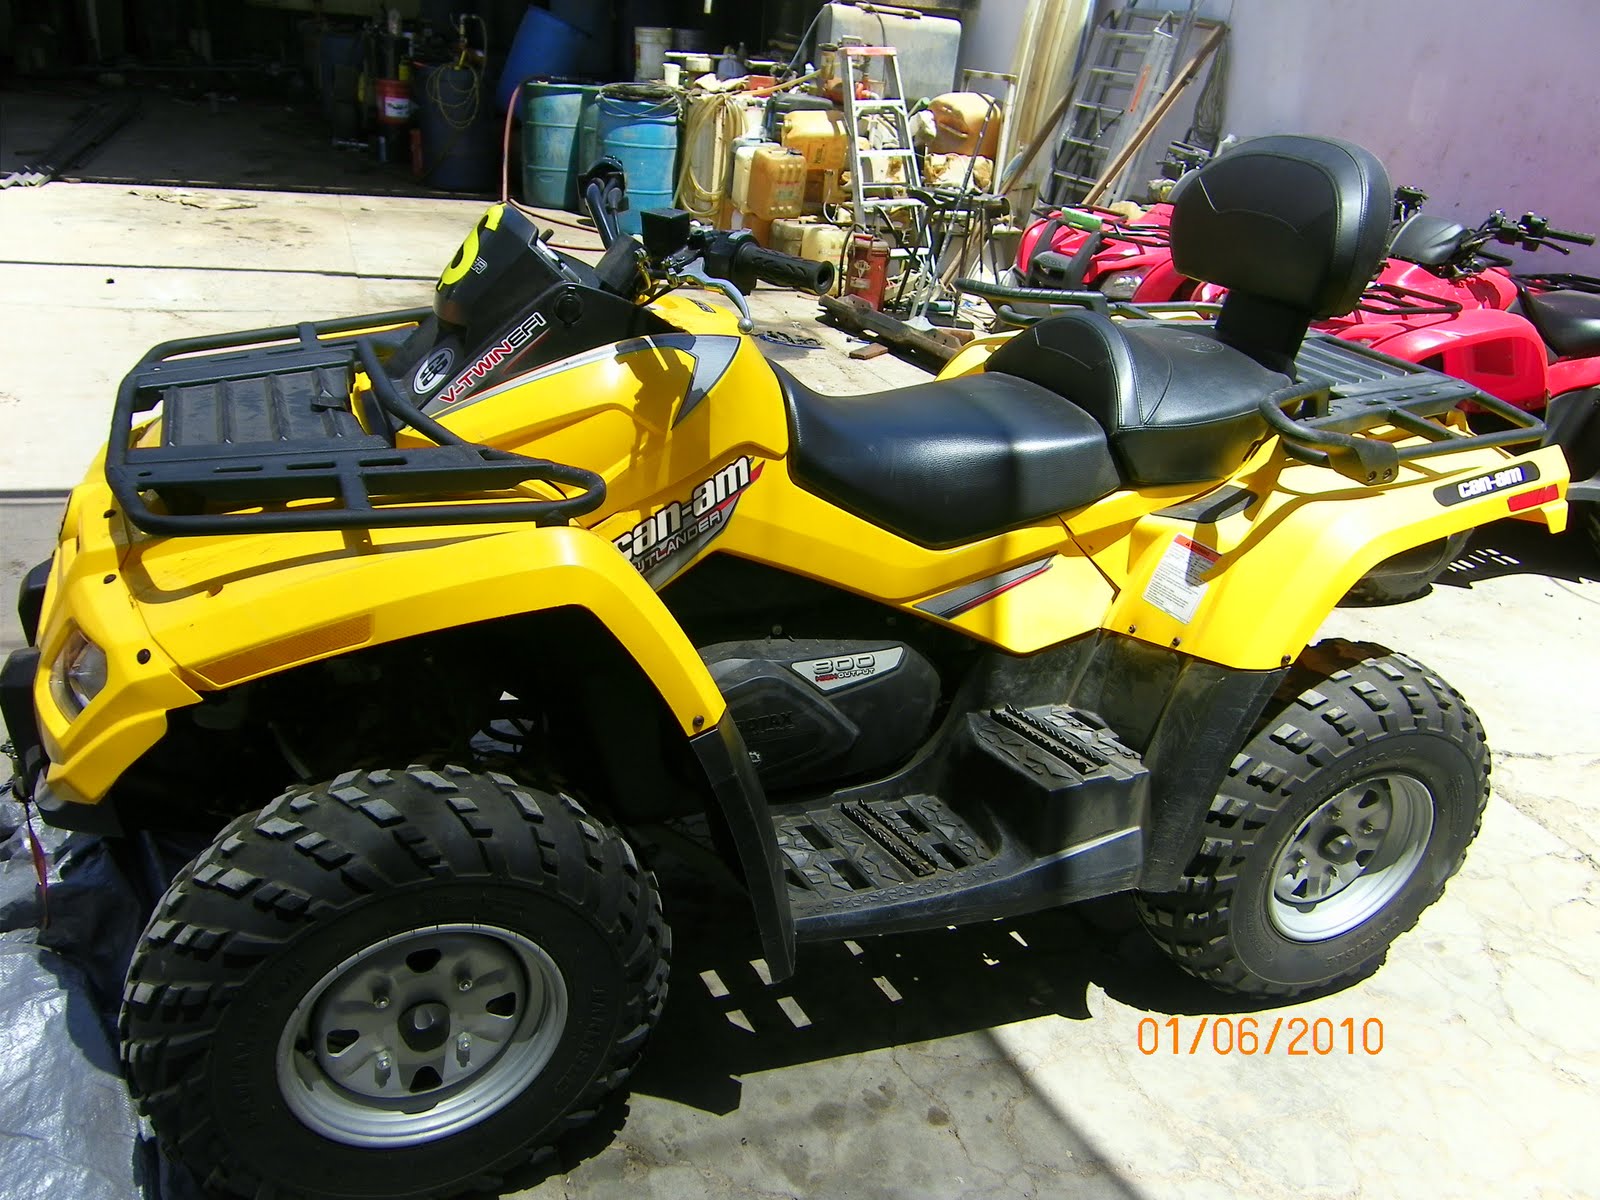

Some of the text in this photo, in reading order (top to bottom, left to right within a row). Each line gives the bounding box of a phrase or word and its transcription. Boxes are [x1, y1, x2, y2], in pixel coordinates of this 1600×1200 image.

[1457, 466, 1524, 499] can-am
[613, 455, 751, 562] can-am
[633, 510, 722, 573] UTLANDER
[812, 653, 875, 674] 800
